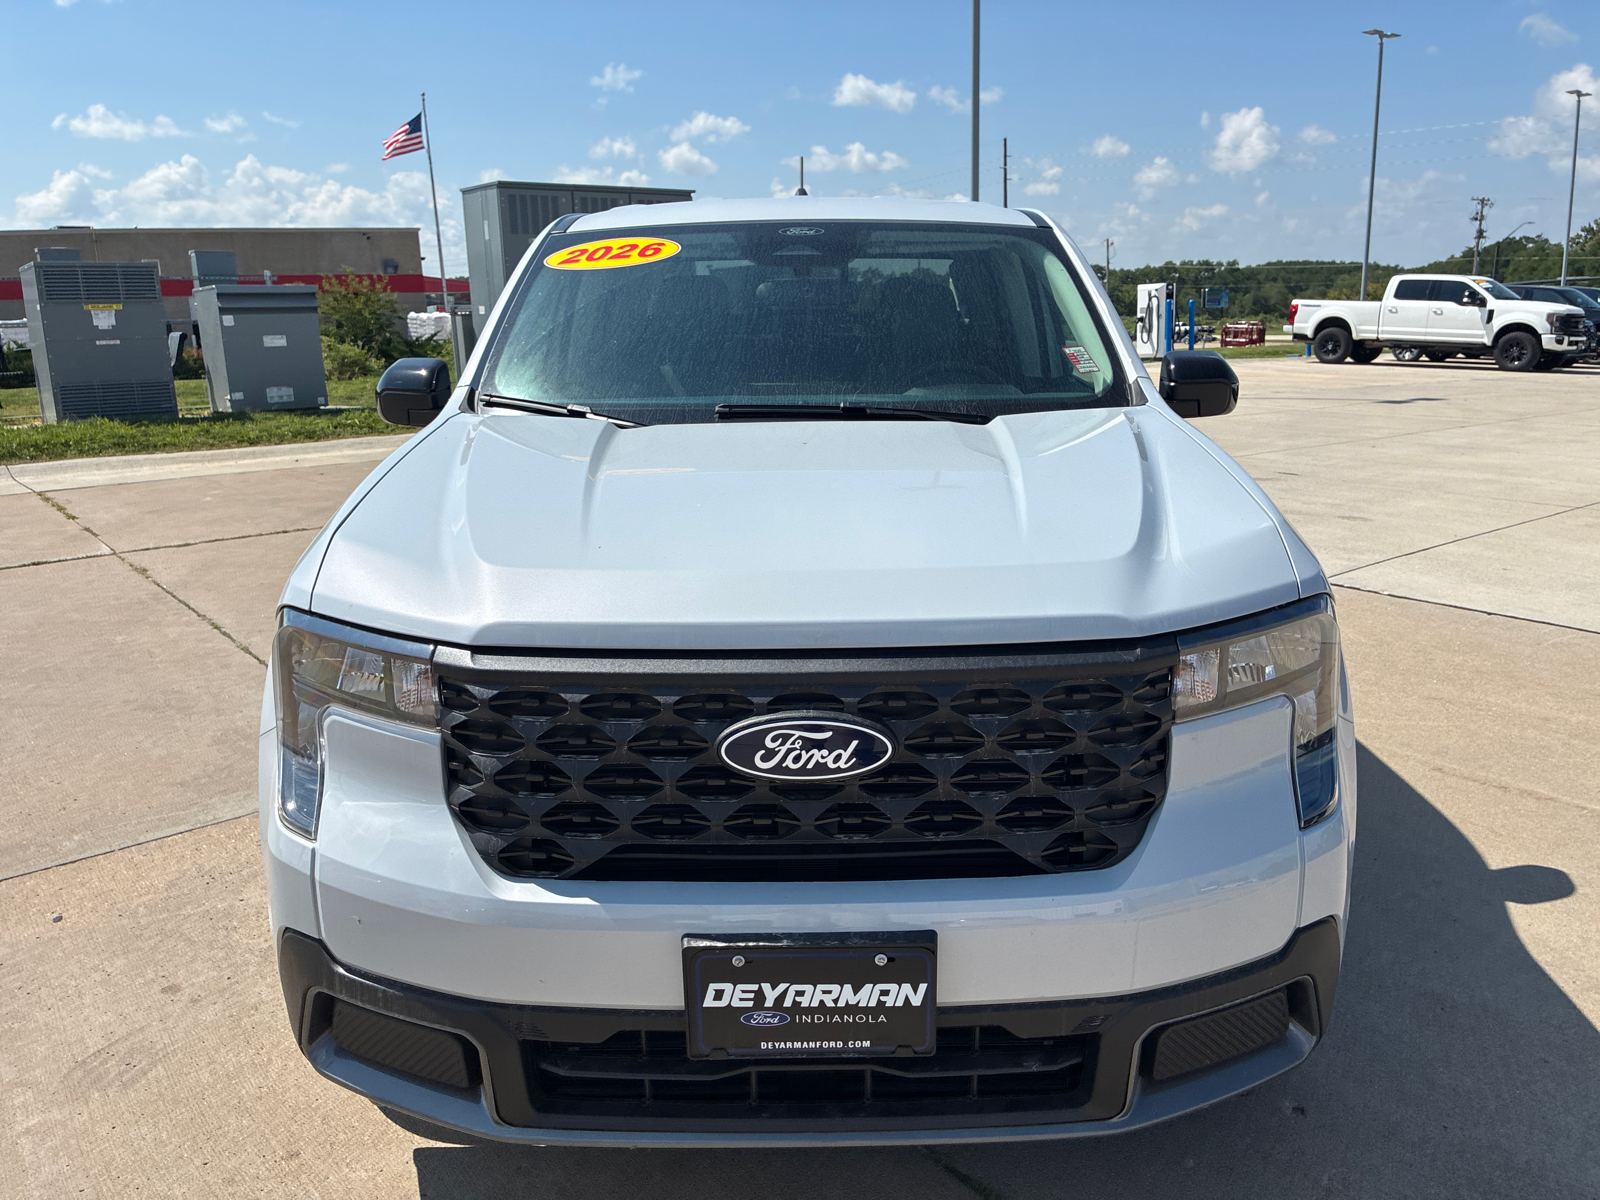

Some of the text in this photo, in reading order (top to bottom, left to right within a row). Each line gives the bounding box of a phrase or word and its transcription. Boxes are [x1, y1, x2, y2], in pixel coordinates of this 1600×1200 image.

[556, 243, 667, 266] 2026
[754, 729, 860, 770] Ford
[702, 983, 928, 1008] DEYARMAN
[750, 1012, 888, 1024] Ford INDIANOLA
[760, 1040, 871, 1050] DEYARMANFORD.COM
